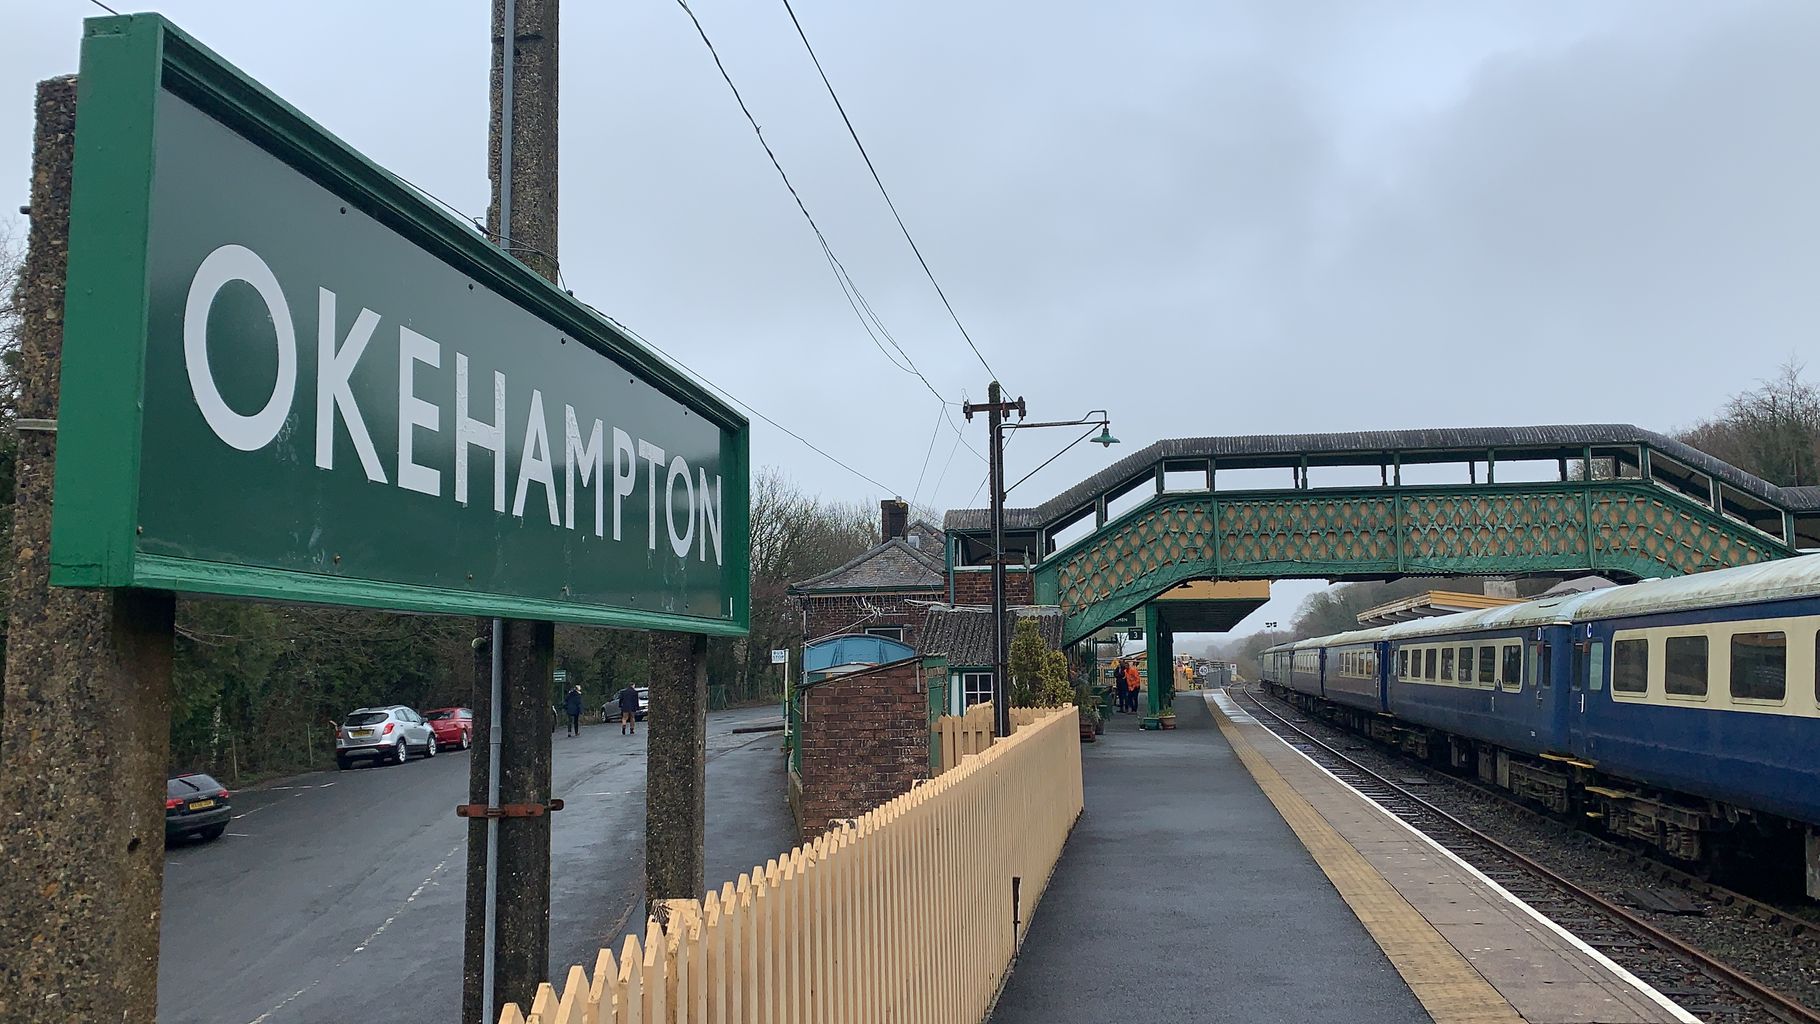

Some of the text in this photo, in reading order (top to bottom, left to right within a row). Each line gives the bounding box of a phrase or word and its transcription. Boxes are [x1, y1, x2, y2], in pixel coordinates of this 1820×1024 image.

[184, 244, 722, 566] OKEHAMPTON
[1133, 631, 1138, 639] 3
[1586, 622, 1593, 639] C
